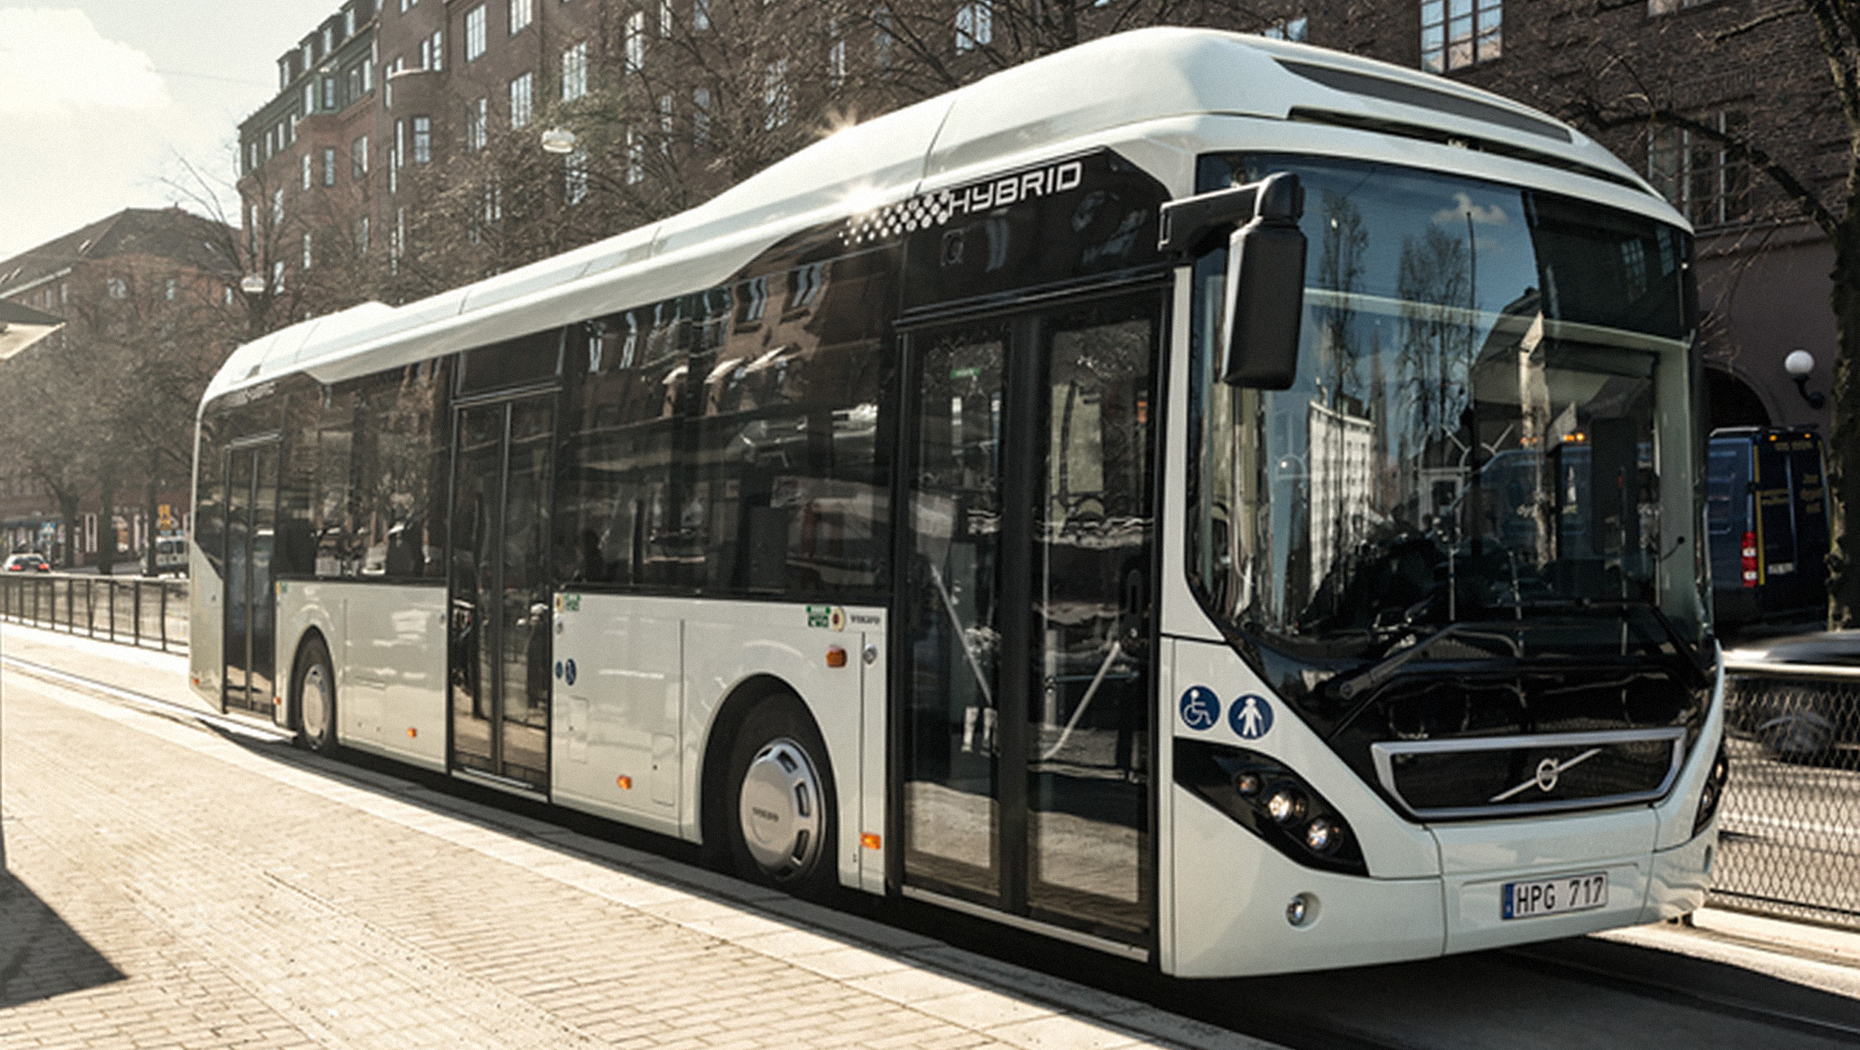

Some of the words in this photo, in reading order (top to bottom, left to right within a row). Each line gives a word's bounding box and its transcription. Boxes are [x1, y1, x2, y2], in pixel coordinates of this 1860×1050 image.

[948, 161, 1082, 217] HYBRID
[1516, 884, 1555, 913] HPG
[1569, 877, 1603, 906] 717
